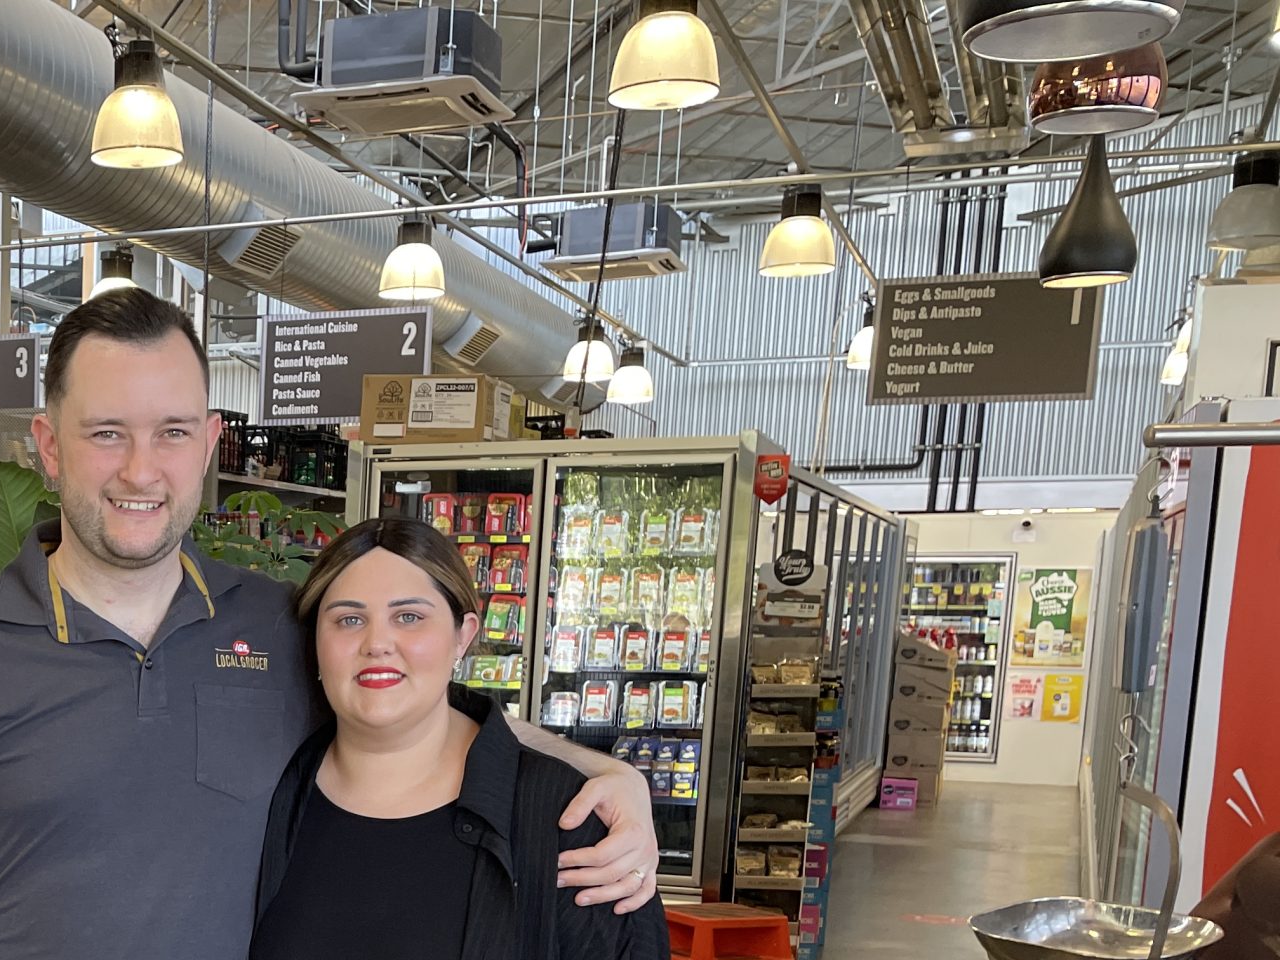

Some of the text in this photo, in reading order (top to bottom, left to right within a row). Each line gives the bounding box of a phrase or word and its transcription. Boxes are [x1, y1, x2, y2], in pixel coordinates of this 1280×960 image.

[894, 285, 996, 304] Eggs & Smallgoods
[892, 305, 982, 322] Dips & Antipasto
[276, 321, 358, 336] International Cuisine
[891, 326, 923, 342] Vegan
[274, 340, 325, 352] Rice & Pasta
[400, 321, 418, 356] 2
[888, 341, 994, 358] Cold Drinks & Juice
[16, 346, 28, 378] 3
[274, 354, 348, 368] Canned Vegetables
[887, 360, 974, 376] Cheese & Butter
[274, 371, 320, 384] Canned Fish
[272, 388, 320, 400] Pasta Sauce
[886, 381, 920, 396] Yogurt
[272, 404, 318, 416] Condiments
[1035, 585, 1074, 598] AUSSIE
[216, 654, 268, 672] LOCAL GROCER
